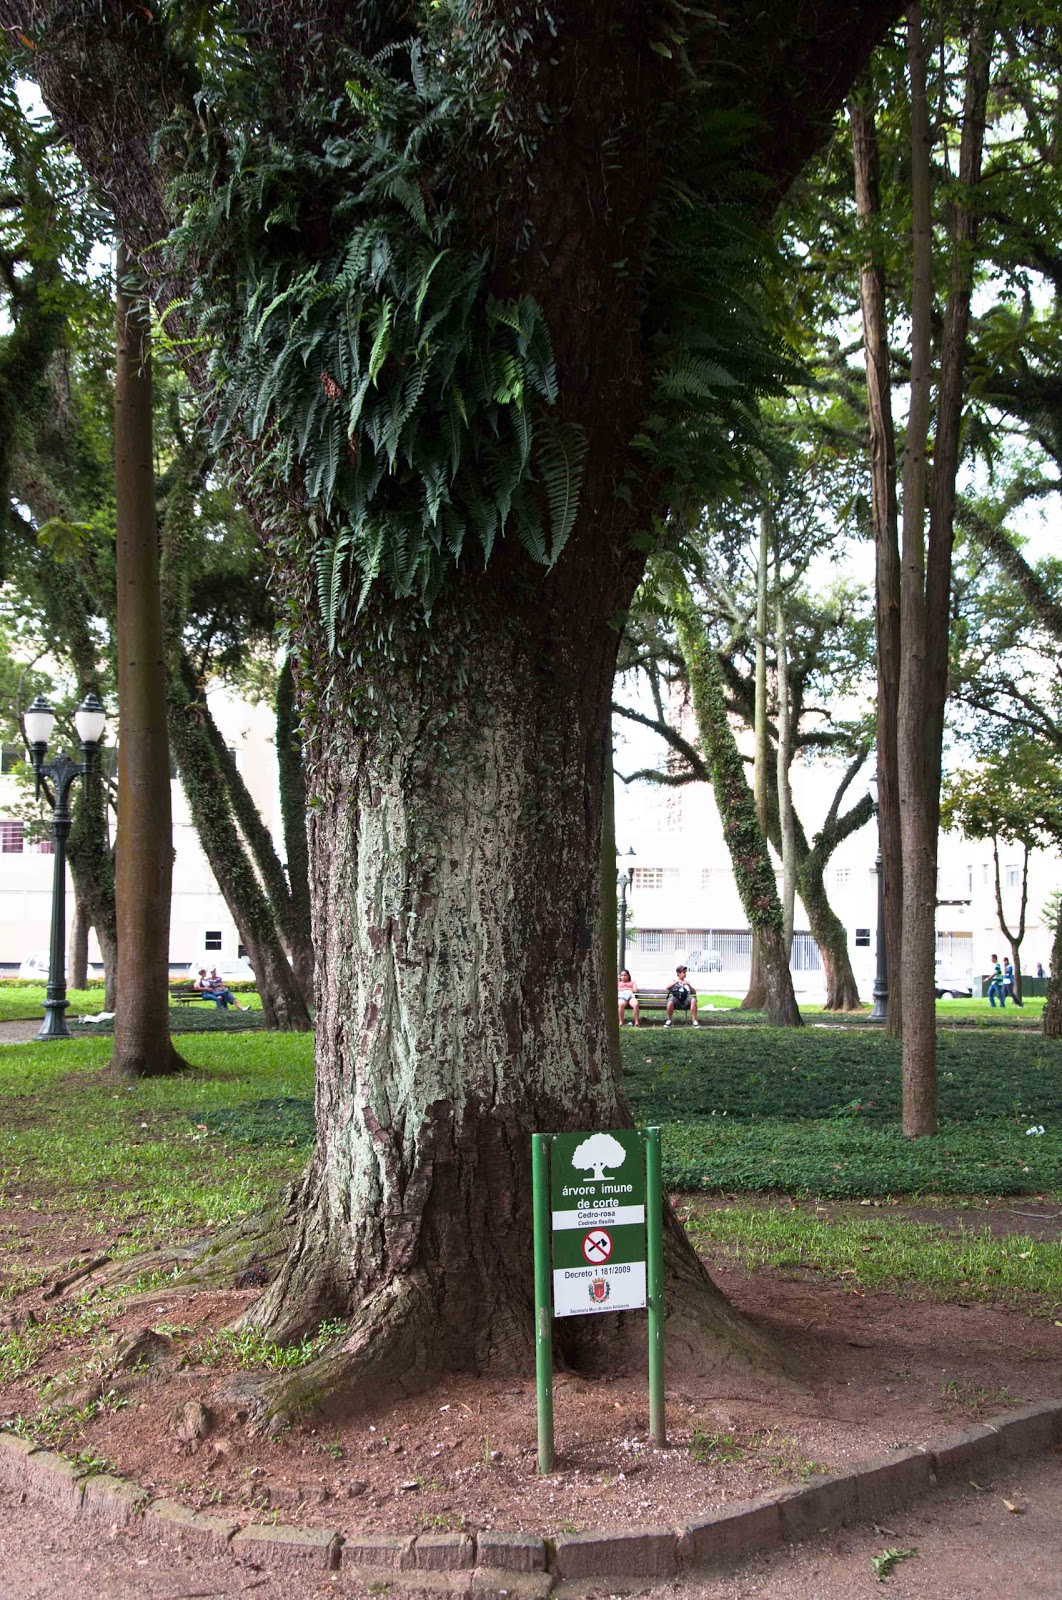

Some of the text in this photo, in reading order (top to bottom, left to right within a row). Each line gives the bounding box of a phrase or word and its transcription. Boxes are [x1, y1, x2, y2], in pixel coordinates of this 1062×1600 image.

[562, 1183, 633, 1196] árvore imune
[577, 1197, 619, 1209] de corte
[577, 1211, 616, 1219] Cedro-rosa
[564, 1270, 593, 1279] Decreto
